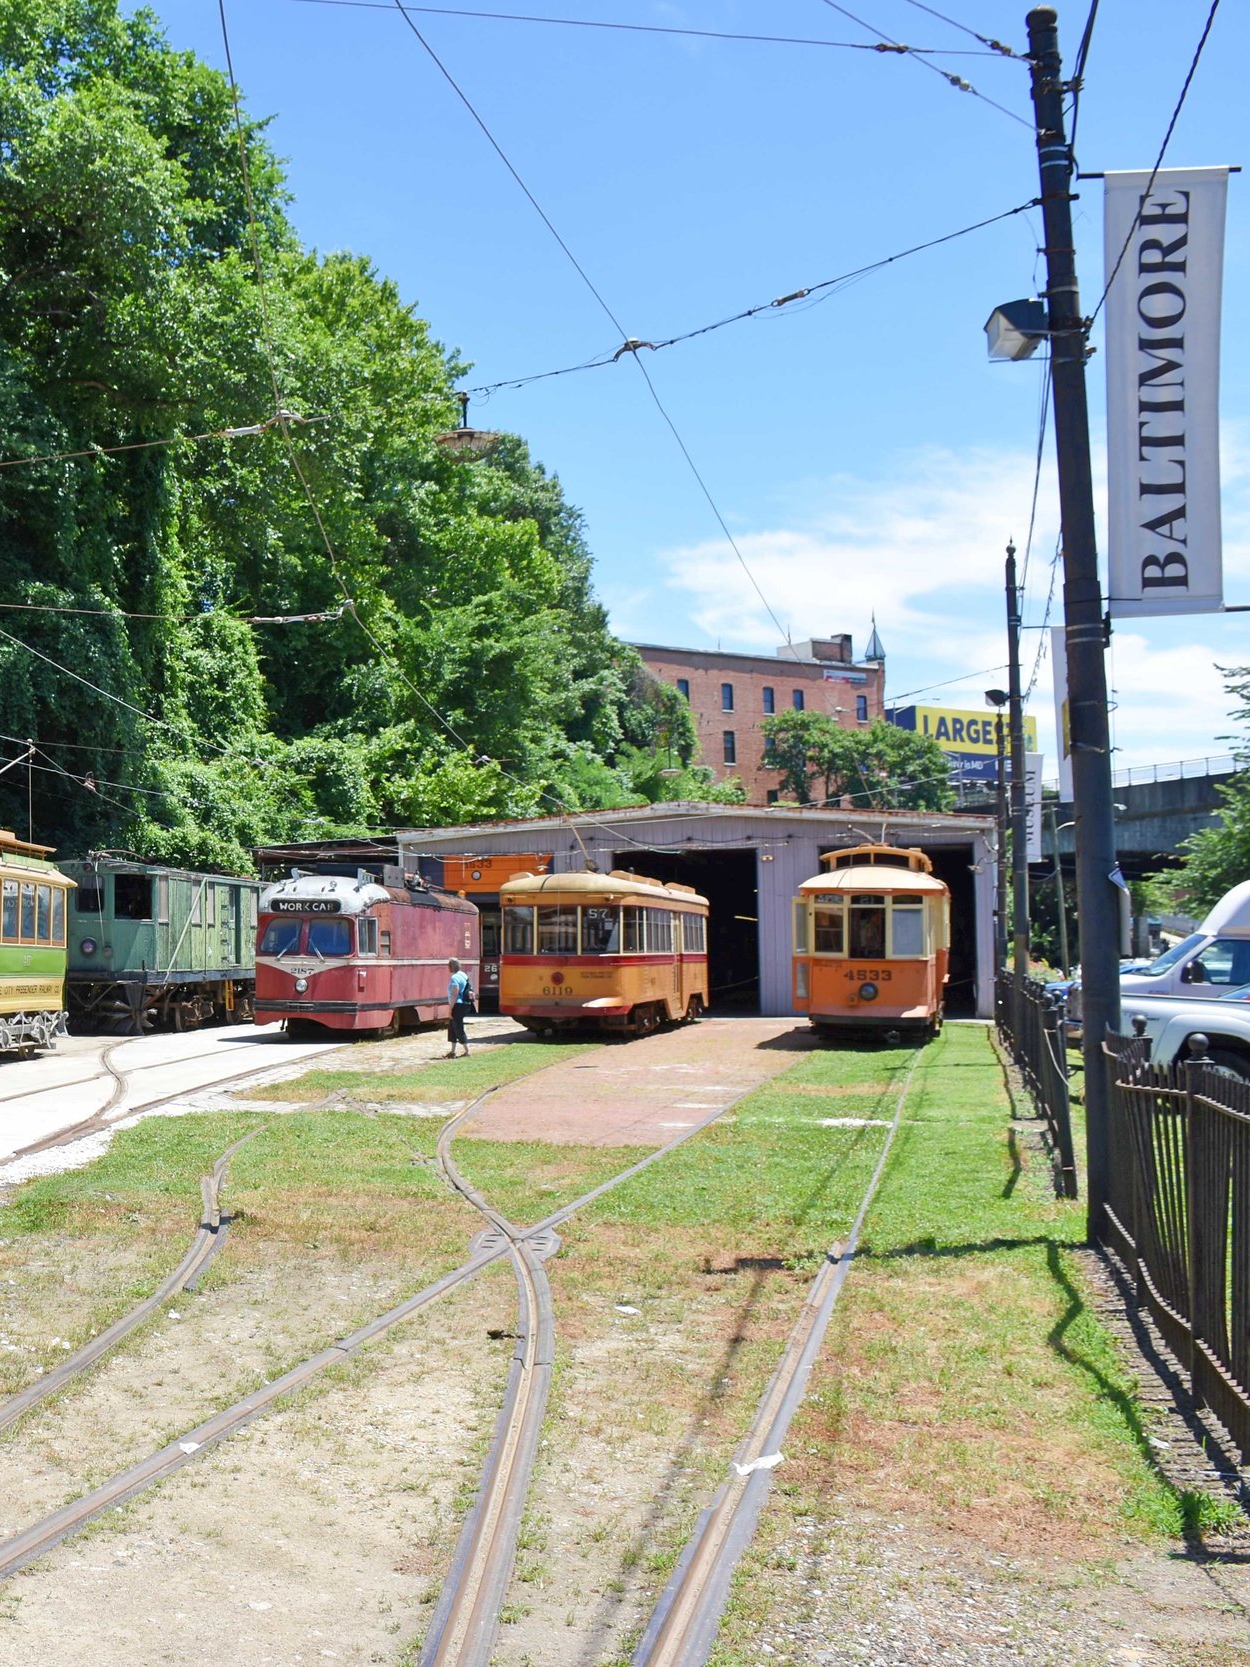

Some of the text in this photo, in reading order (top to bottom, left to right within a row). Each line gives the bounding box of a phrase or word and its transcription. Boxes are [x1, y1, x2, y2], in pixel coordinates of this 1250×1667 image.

[1137, 189, 1190, 593] BALTIMORE
[923, 714, 1028, 746] LARGE
[279, 902, 334, 911] WORK CAR
[589, 908, 608, 919] 57
[844, 969, 892, 981] 4533
[4, 985, 14, 995] CITY
[543, 986, 573, 996] 6119
